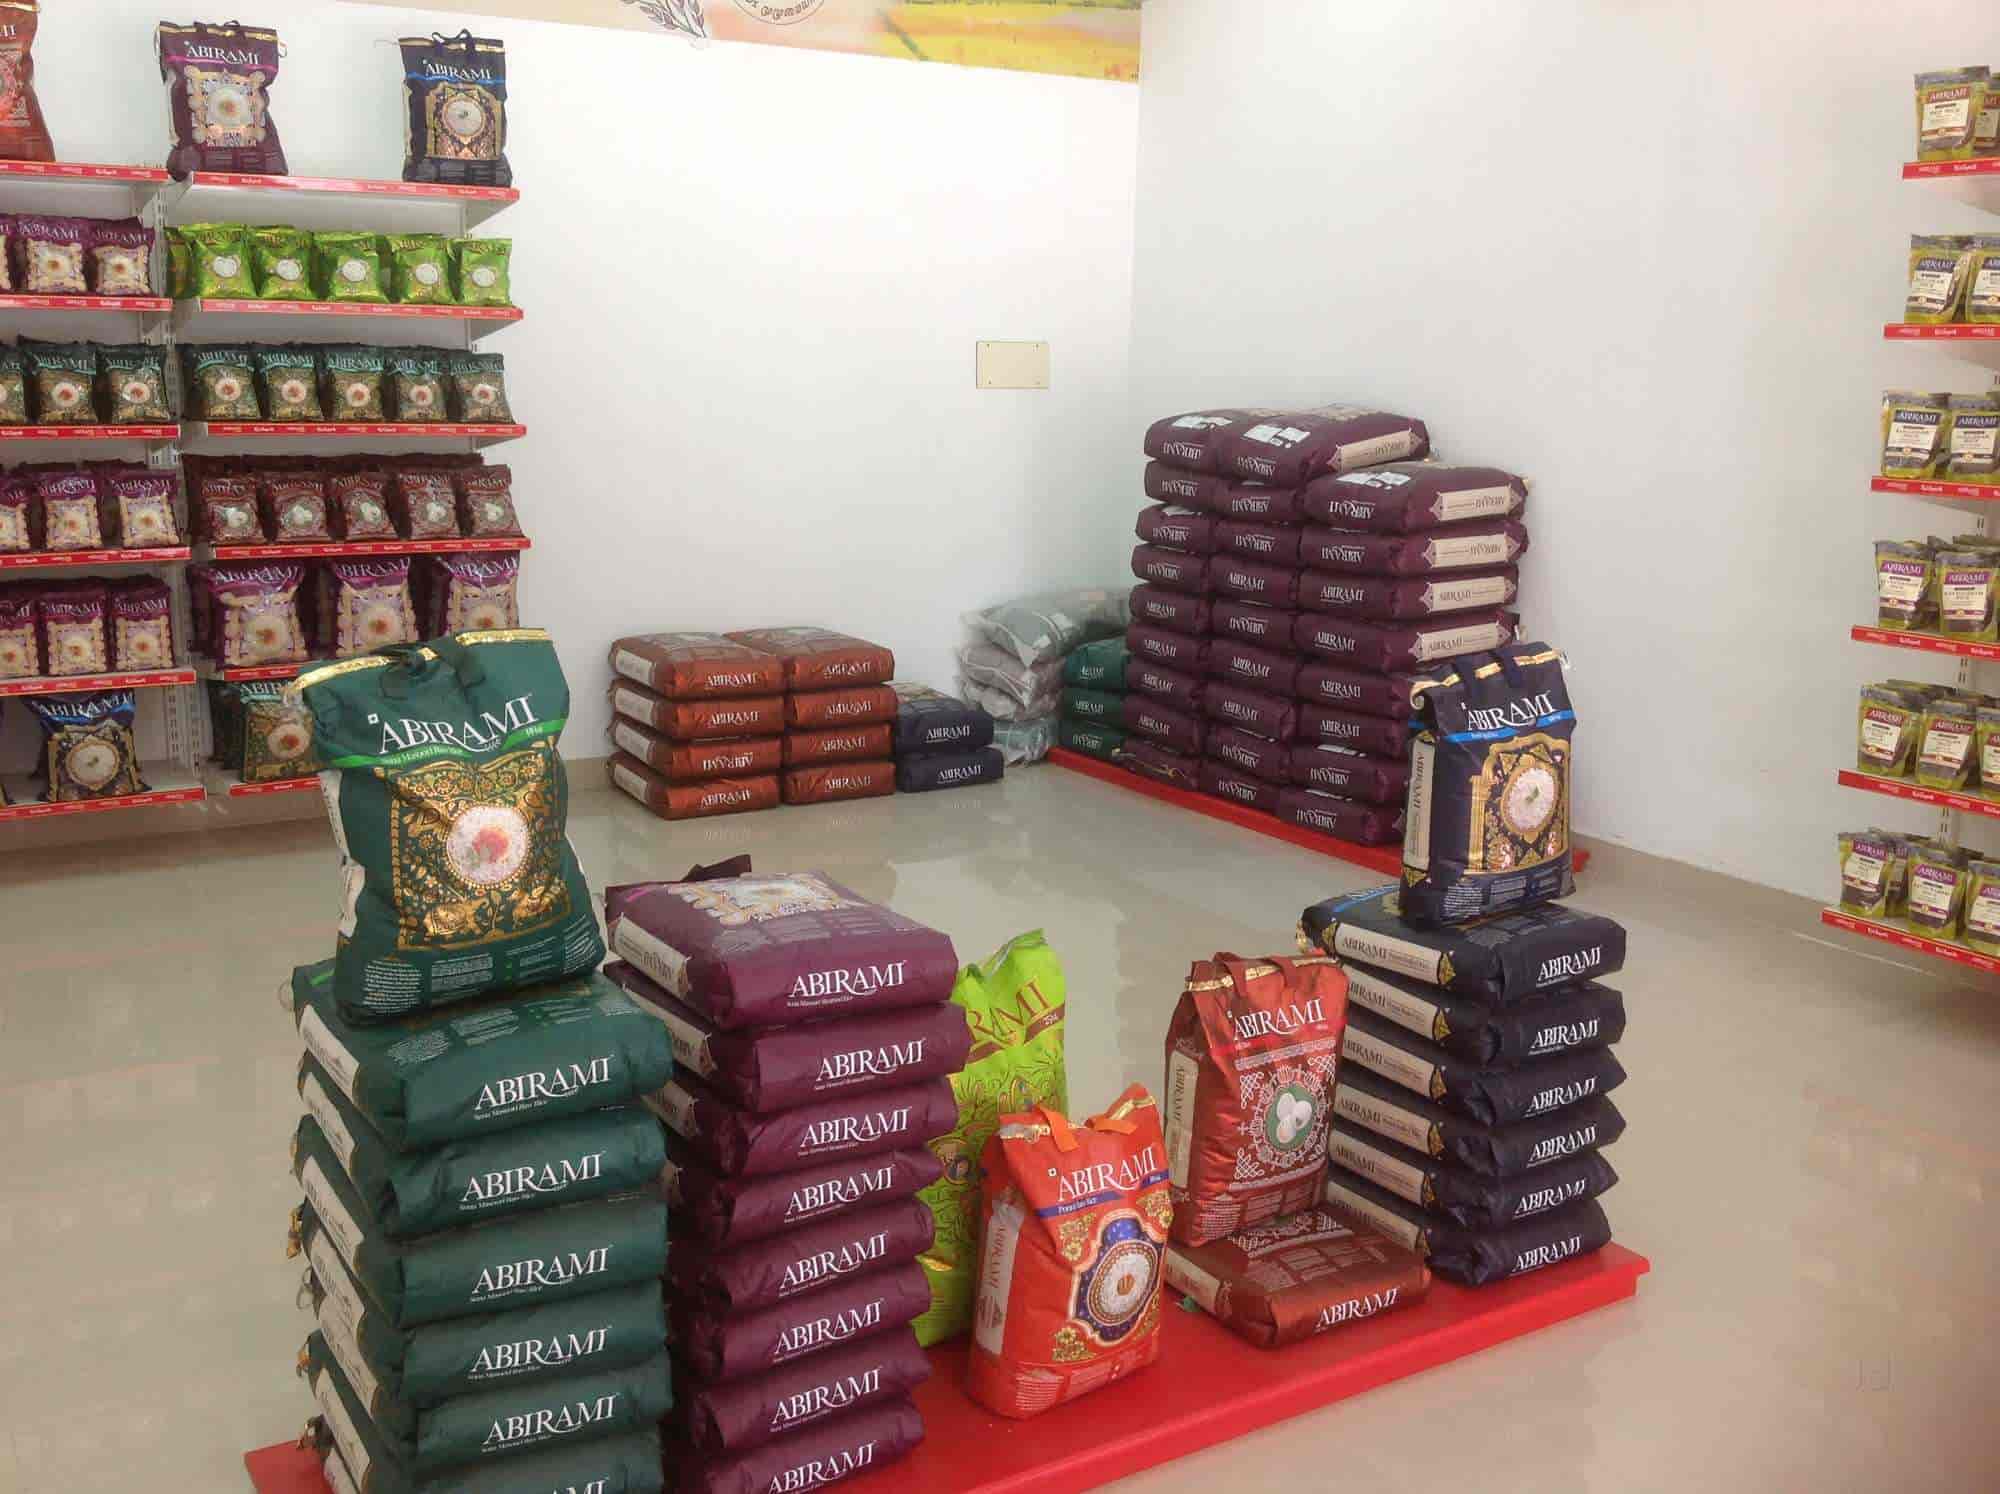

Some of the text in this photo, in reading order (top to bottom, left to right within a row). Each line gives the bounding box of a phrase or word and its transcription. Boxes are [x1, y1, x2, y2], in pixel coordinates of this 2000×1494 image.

[187, 44, 260, 66] ABIRAMI
[426, 61, 493, 81] ABIRAMI
[705, 672, 757, 688] ABIRAMI
[824, 662, 871, 678] ABIRAMI
[40, 690, 132, 719] ABIRAMI
[709, 711, 760, 727] ABIRAMI
[826, 700, 872, 716] ABIRAMI
[1468, 694, 1556, 730] ABIRAMI
[380, 695, 539, 753] ABIRAMI
[926, 725, 970, 740] ABIRAMI
[821, 737, 866, 753] ABIRAMI
[825, 776, 872, 792] ABIRAMI
[937, 765, 982, 781] ABIRAMI
[701, 792, 752, 808] ABIRAMI
[1342, 936, 1388, 961] ABIRAMI
[1537, 948, 1601, 981] ABIRAMI
[788, 962, 905, 997] ABIRAMI
[967, 977, 1052, 1046] RAMI
[1234, 999, 1326, 1040] ABIRAMI
[1531, 1020, 1599, 1050] ABIRAMI
[816, 1040, 924, 1081] ABIRAMI
[475, 1057, 611, 1110] ABIRAMI
[1526, 1078, 1597, 1113] ABIRAMI
[800, 1108, 912, 1147] ABIRAMI
[1529, 1126, 1597, 1162] ABIRAMI
[462, 1153, 602, 1201] ABIRAMI
[786, 1167, 894, 1215] ABIRAMI
[1058, 1147, 1157, 1202] ABIRAMI
[1515, 1179, 1587, 1215] ABIRAMI
[472, 1248, 609, 1293] ABIRAMI
[780, 1233, 887, 1289] ABIRAMI
[1513, 1236, 1583, 1273] ABIRAMI
[1316, 1287, 1400, 1328] ABIRAMI
[774, 1301, 882, 1353] ABIRAMI
[471, 1329, 608, 1372] ABIRAMI
[772, 1369, 881, 1424] ABIRAMI
[484, 1395, 618, 1445] ABIRAMI
[769, 1443, 875, 1494] ABIRAMI
